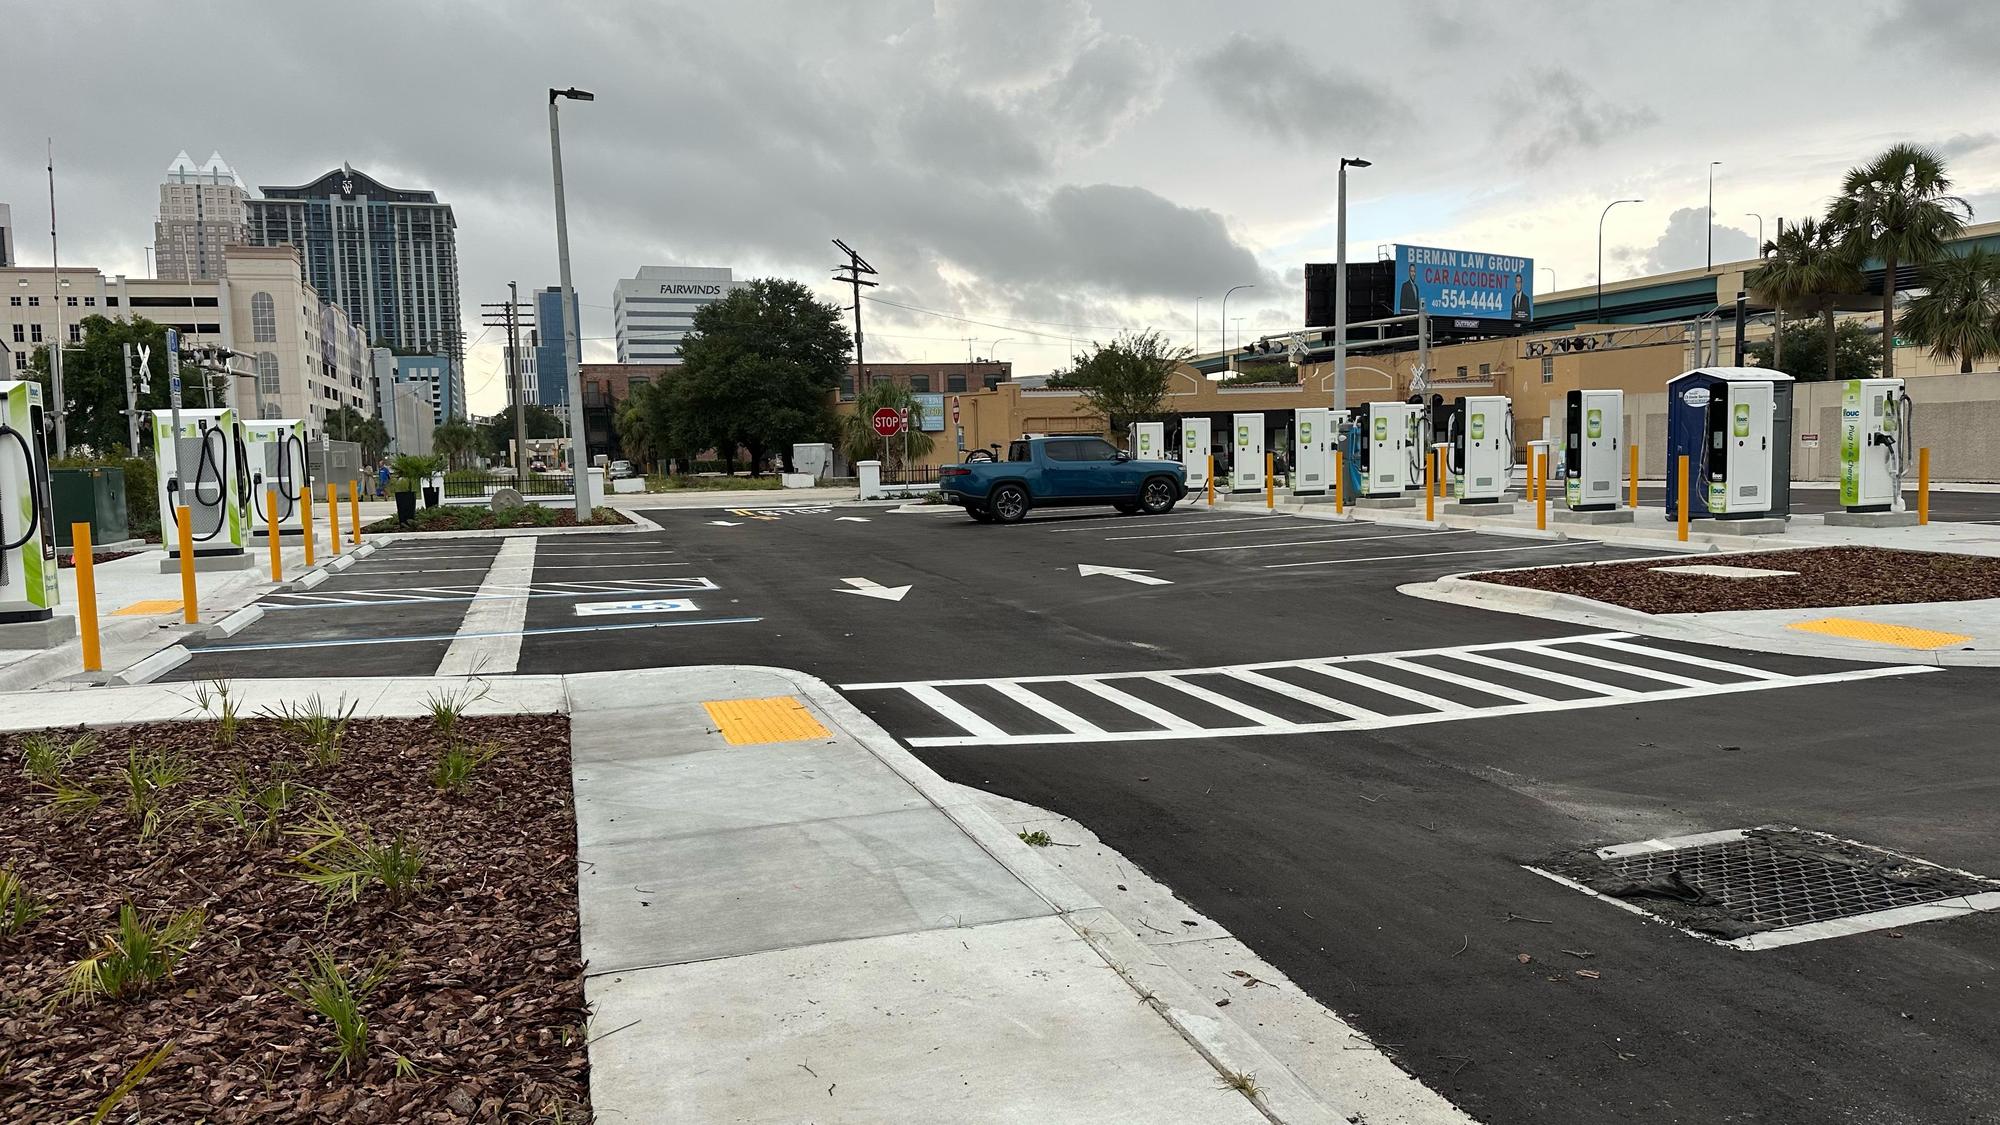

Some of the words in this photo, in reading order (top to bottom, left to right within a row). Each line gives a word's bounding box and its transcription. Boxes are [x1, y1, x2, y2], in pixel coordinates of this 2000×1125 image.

[1407, 248, 1456, 267] BERMAN
[1461, 253, 1484, 270] LAW
[1488, 256, 1525, 273] GROUP
[1425, 268, 1449, 285] CAR
[1453, 269, 1510, 289] ACCIDENT
[660, 284, 721, 295] FAIRWINDS
[1442, 288, 1503, 311] 554-4444
[875, 416, 899, 428] STOP
